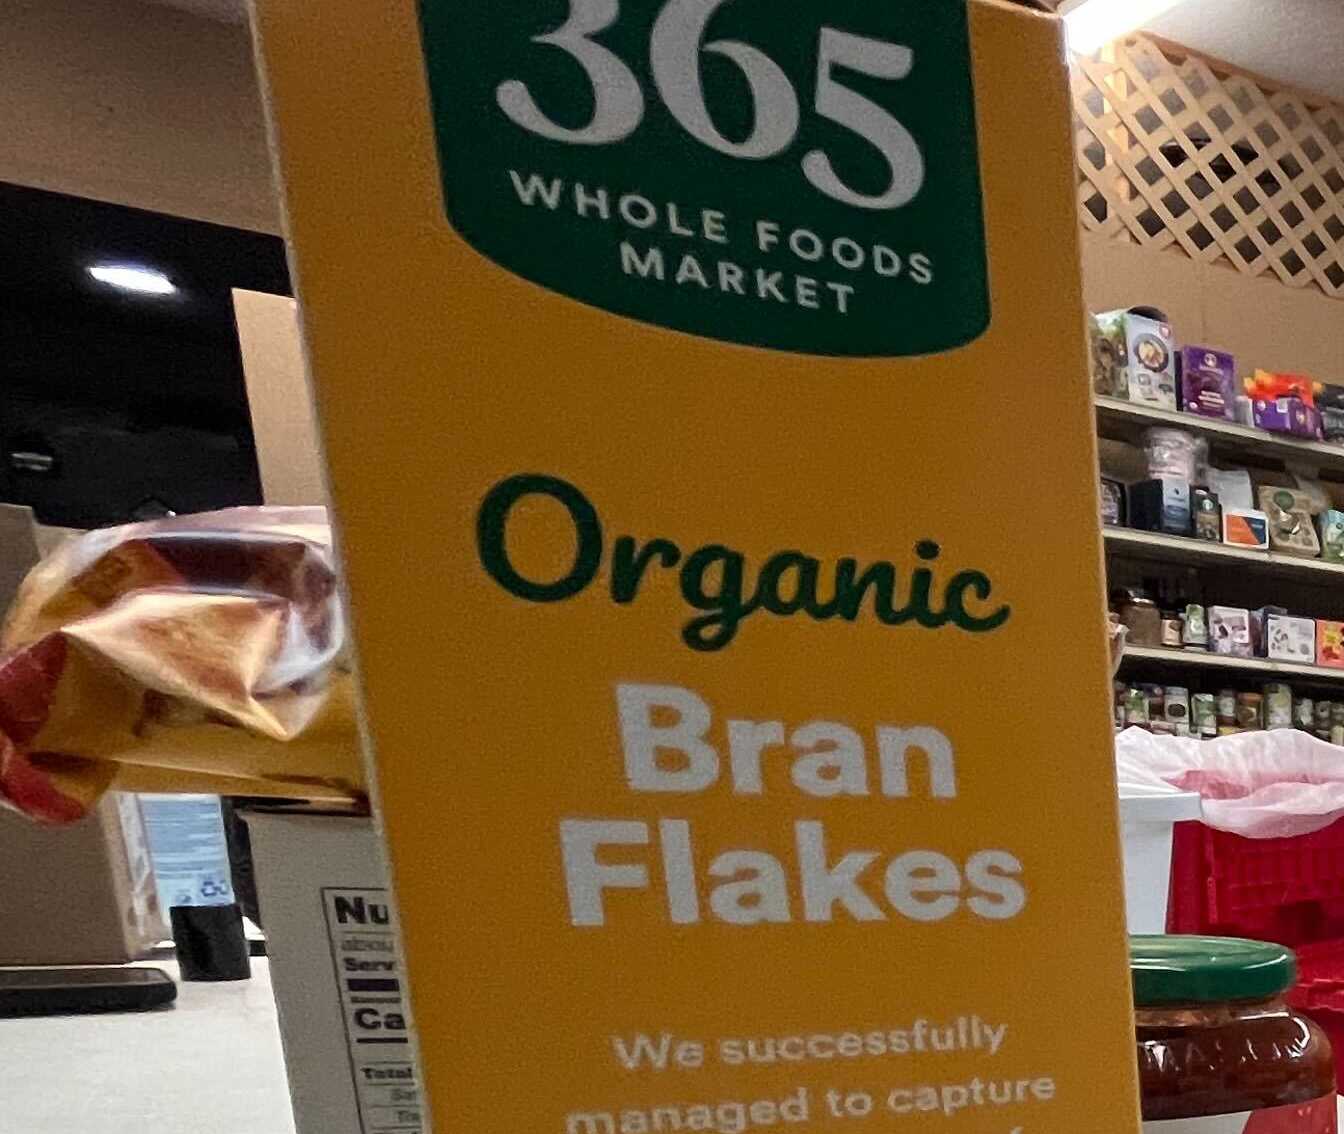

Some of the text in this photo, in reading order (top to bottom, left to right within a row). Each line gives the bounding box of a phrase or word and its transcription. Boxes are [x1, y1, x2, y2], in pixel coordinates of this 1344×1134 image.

[496, 0, 925, 210] 365
[509, 169, 934, 284] WHOLE FOODS
[619, 242, 855, 314] MARKET
[475, 472, 1010, 651] Organic
[615, 682, 957, 797] Bran
[560, 819, 1028, 927] Flakes
[611, 1013, 1009, 1071] We successfully
[826, 1086, 872, 1116] to
[888, 1072, 1056, 1116] capture
